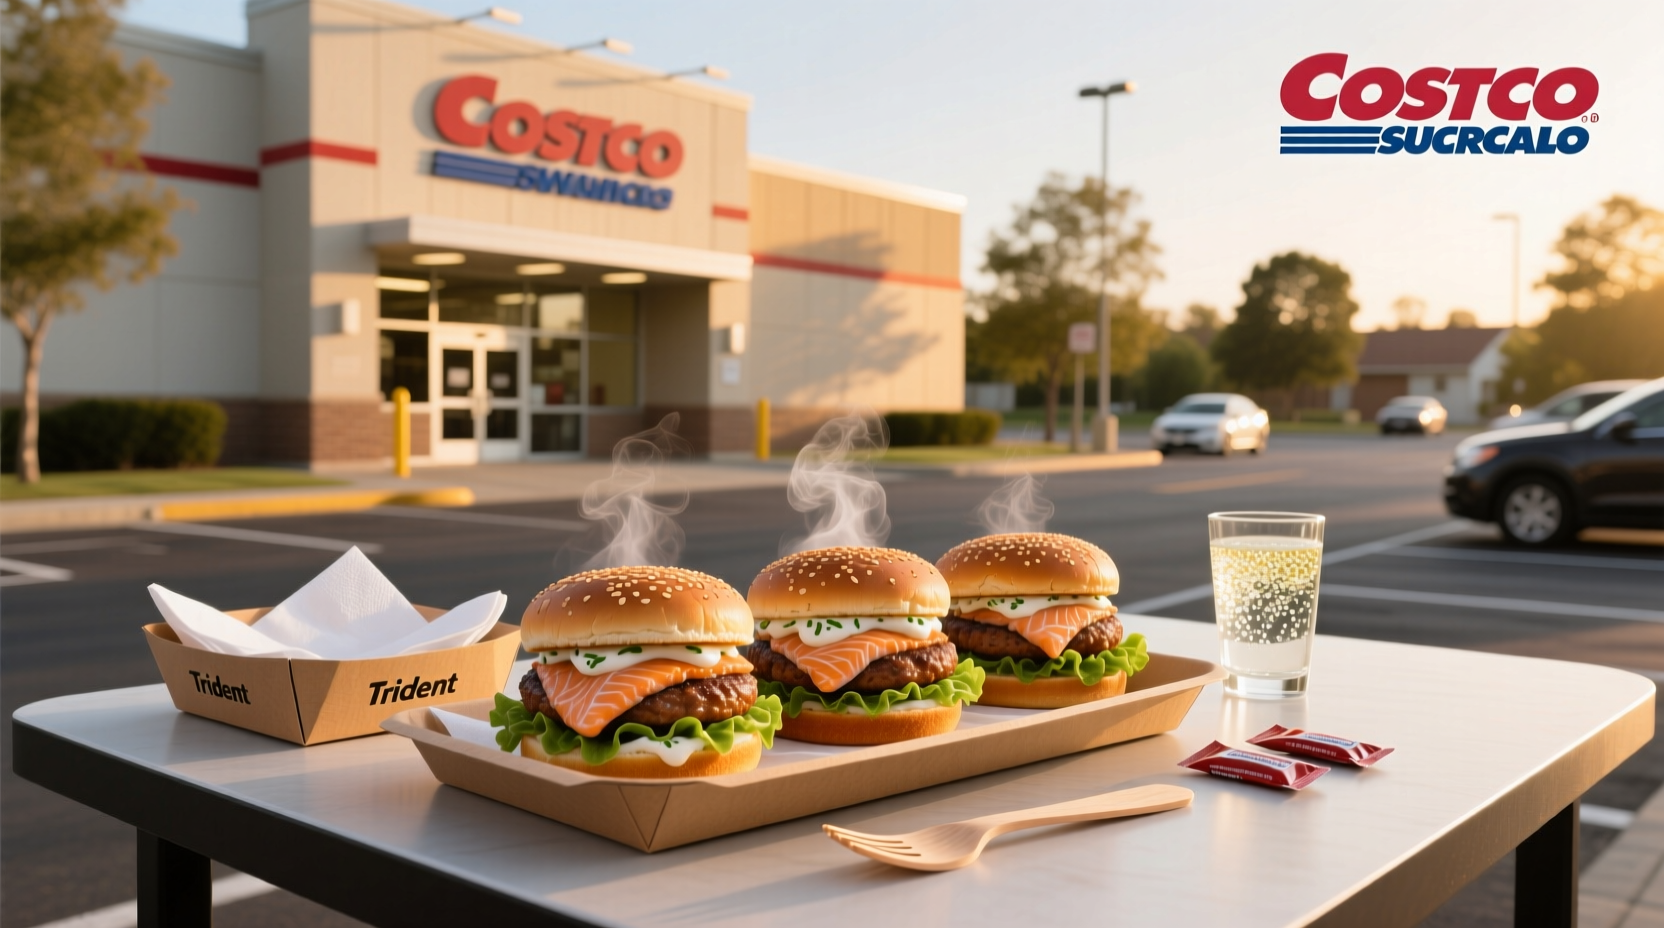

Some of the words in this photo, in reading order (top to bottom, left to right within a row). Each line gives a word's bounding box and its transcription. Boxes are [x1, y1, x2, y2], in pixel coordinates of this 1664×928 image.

[433, 74, 683, 179] COSTCO
[188, 669, 252, 706] Trident
[368, 672, 459, 706] Trident
